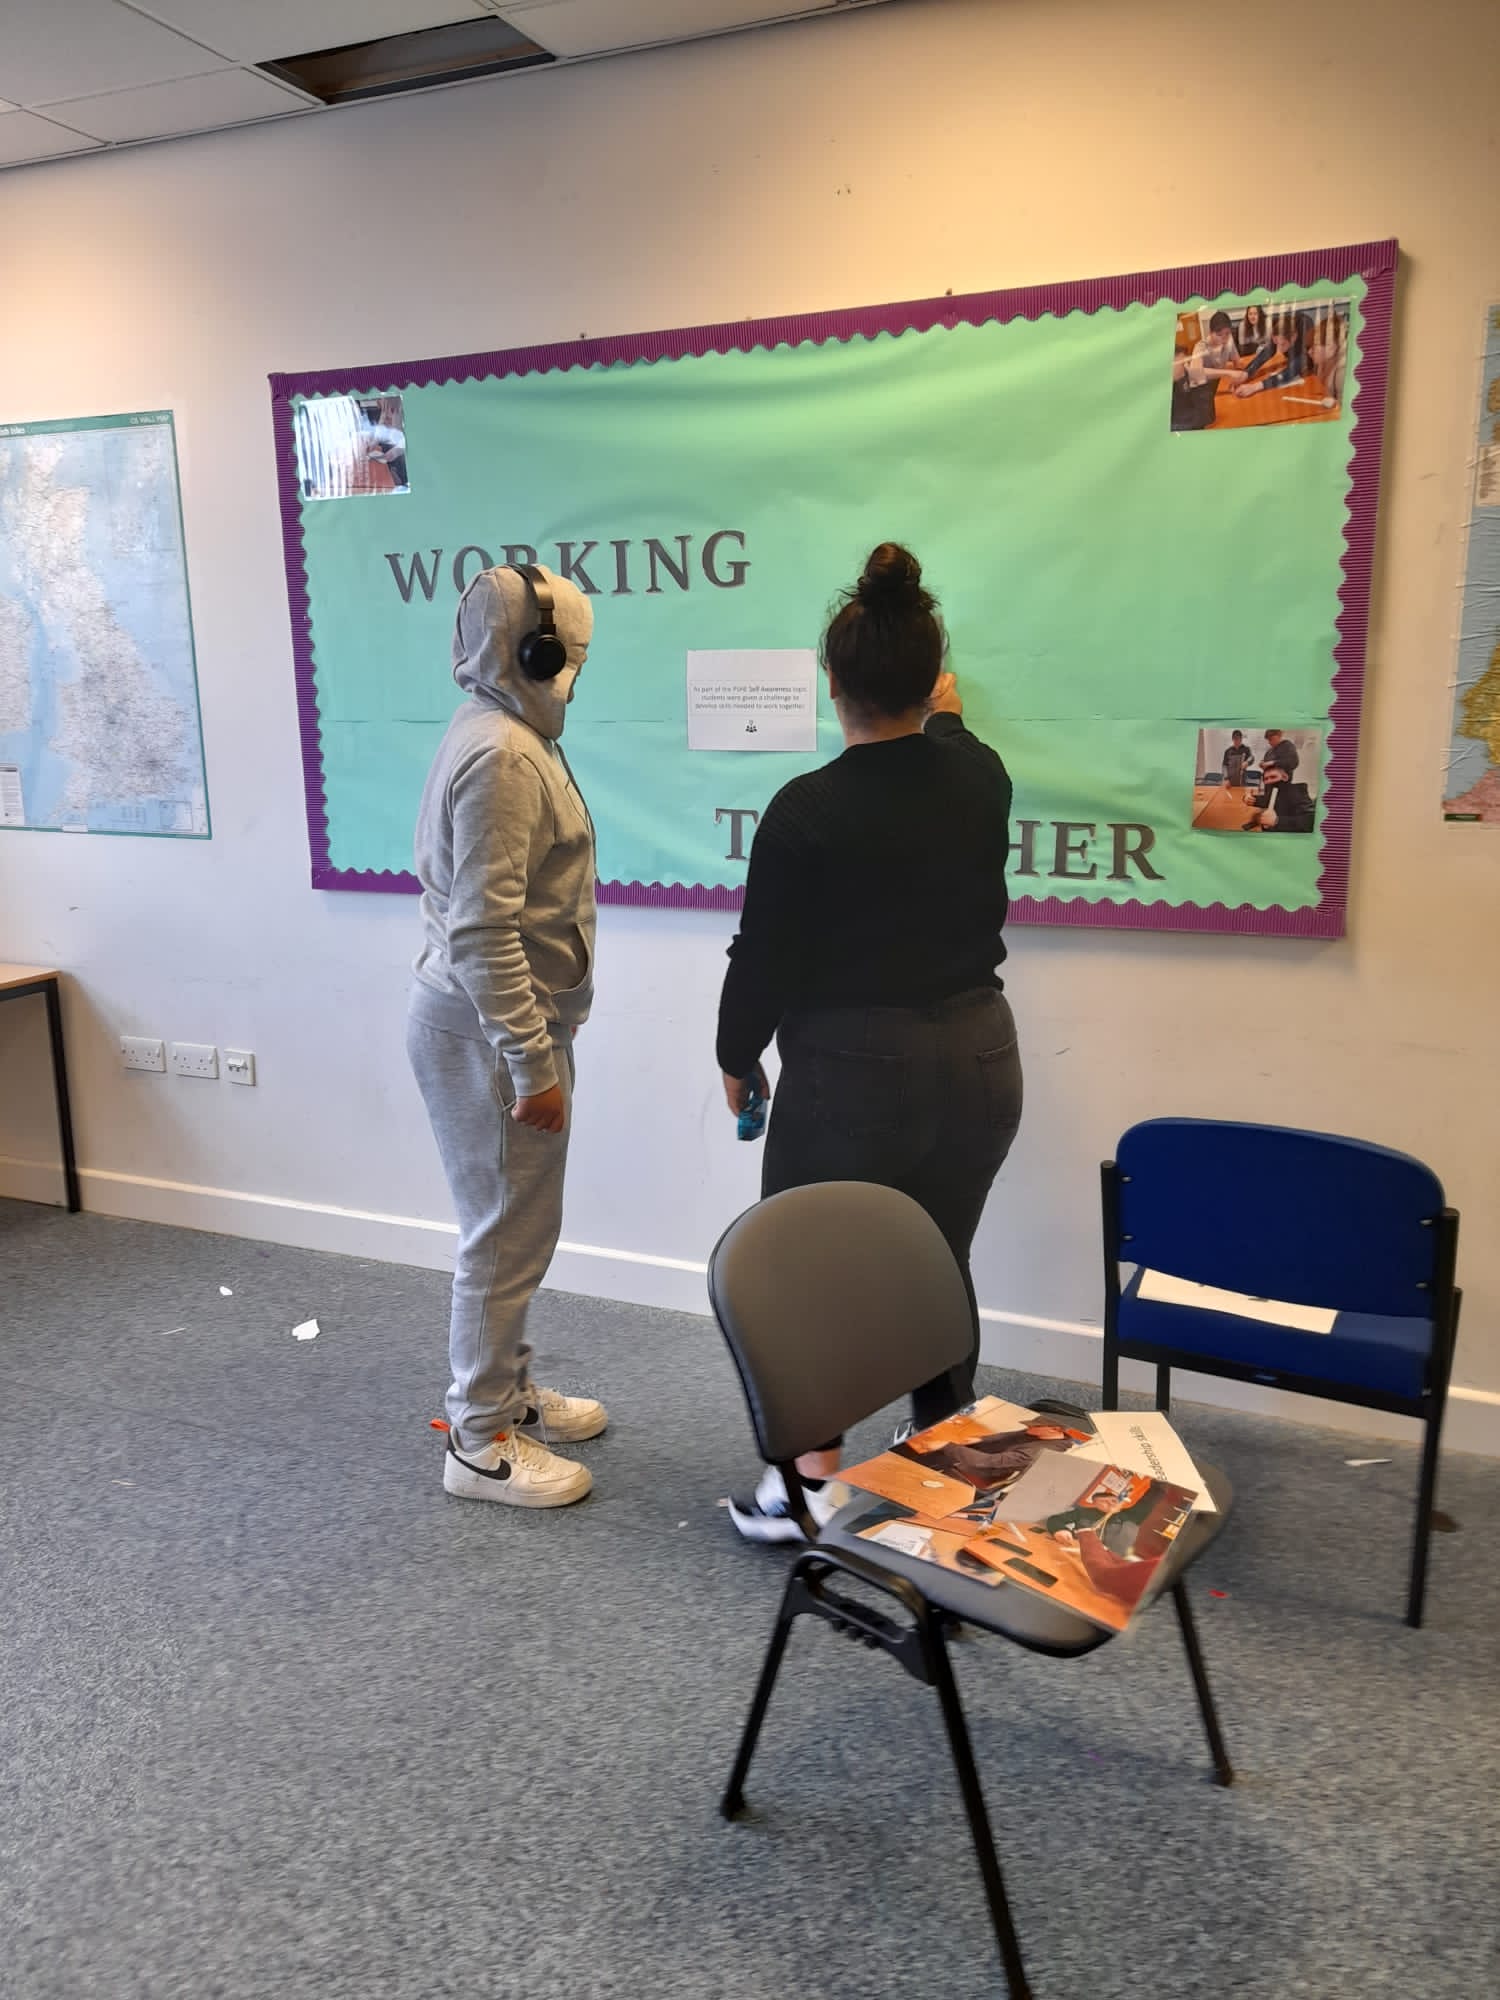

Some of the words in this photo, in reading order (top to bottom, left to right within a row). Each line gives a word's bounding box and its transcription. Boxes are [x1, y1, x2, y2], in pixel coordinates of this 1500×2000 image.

[761, 685, 791, 693] Awareness
[701, 694, 725, 702] students
[727, 694, 741, 702] were
[742, 694, 757, 702] given
[764, 694, 791, 702] challenge
[733, 703, 754, 711] needed
[763, 703, 778, 711] work
[713, 807, 1167, 882] THER
